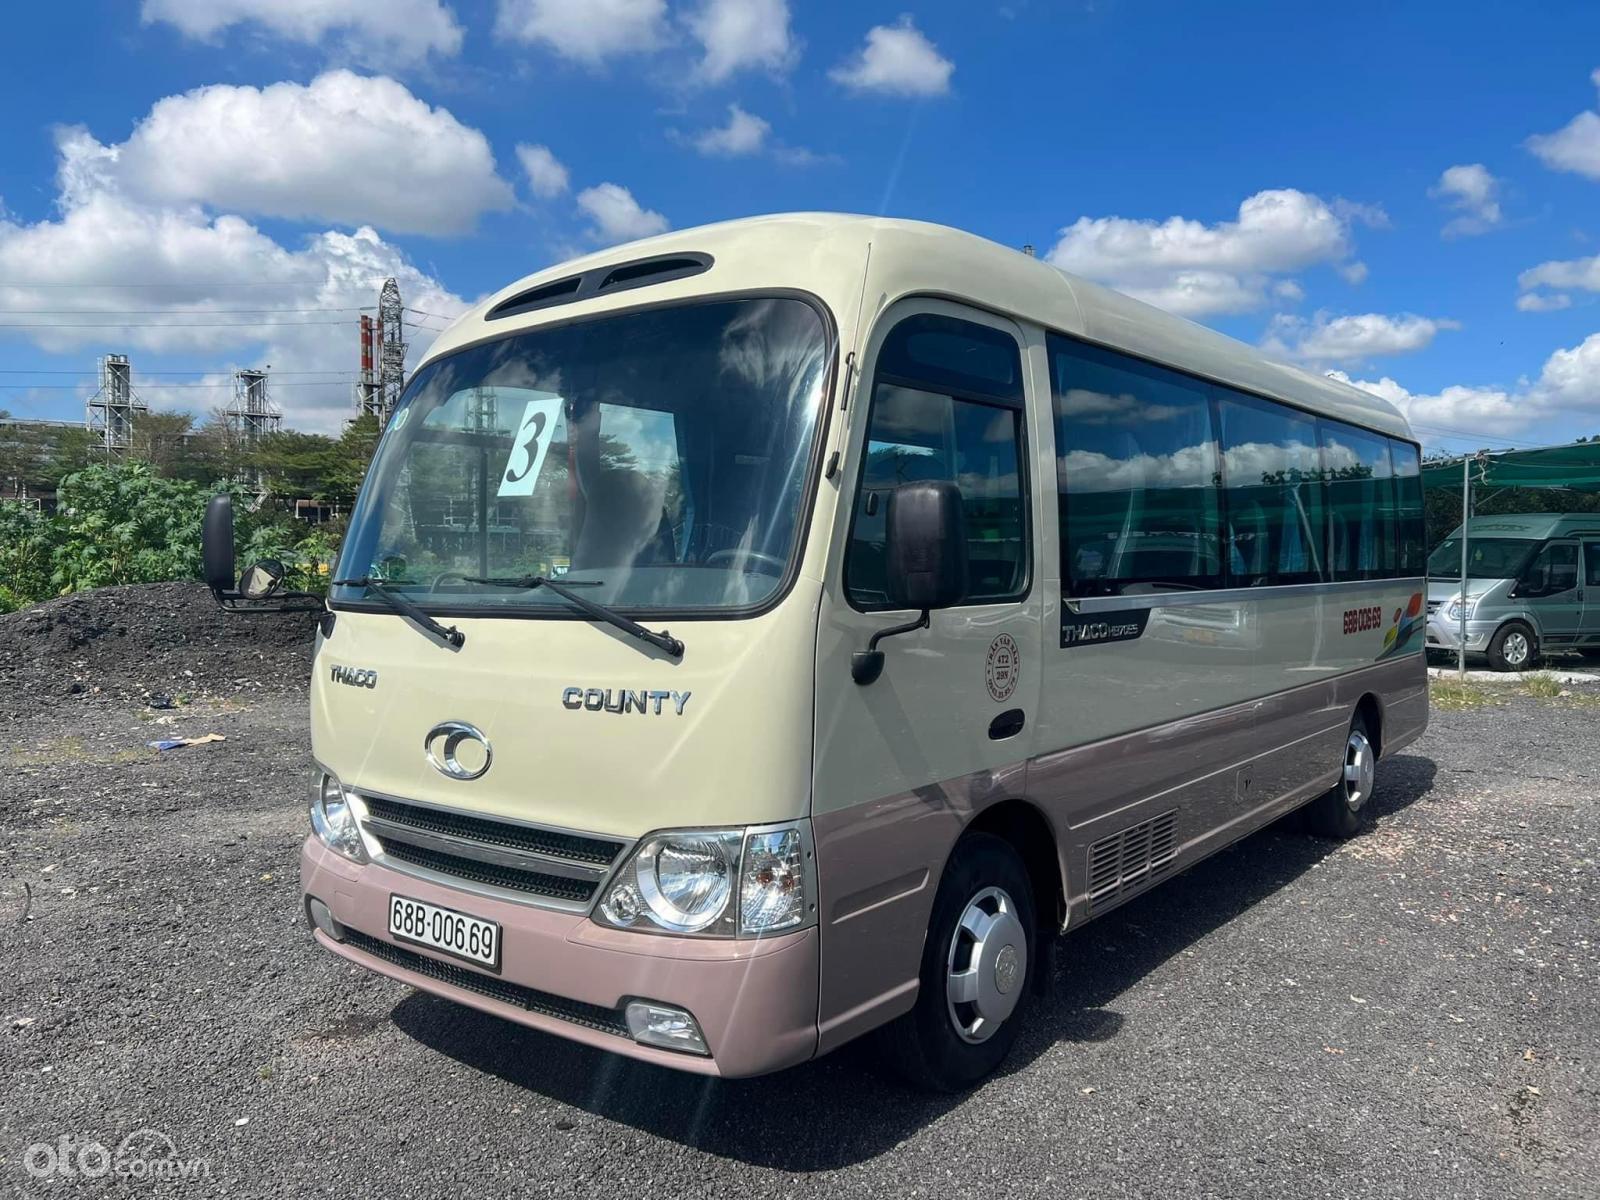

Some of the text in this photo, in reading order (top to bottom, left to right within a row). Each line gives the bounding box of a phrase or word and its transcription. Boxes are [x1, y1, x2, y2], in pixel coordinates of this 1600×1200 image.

[506, 412, 546, 482] 3
[1062, 622, 1107, 642] THACO
[331, 664, 377, 689] THACO
[562, 687, 691, 715] COUNTY
